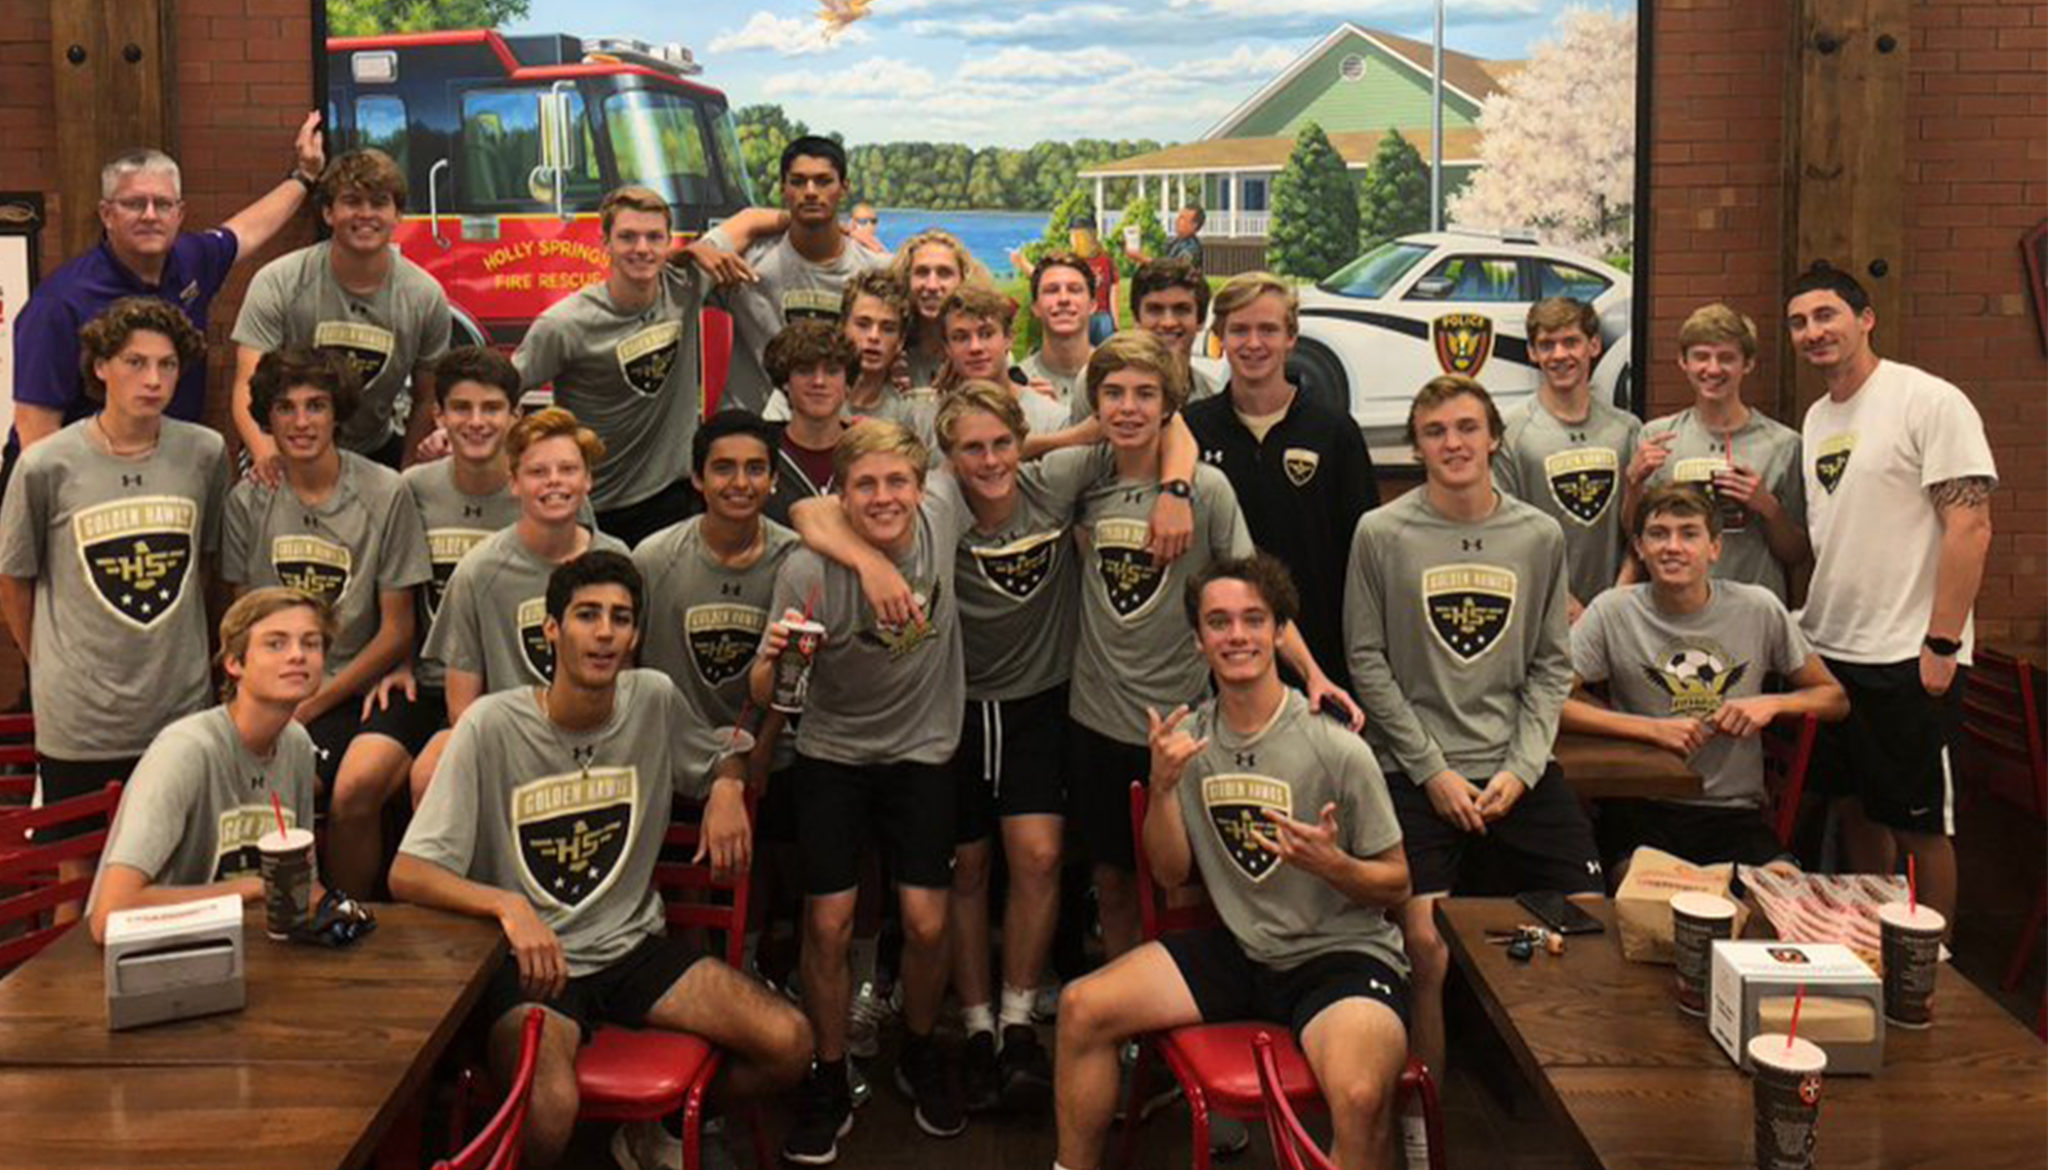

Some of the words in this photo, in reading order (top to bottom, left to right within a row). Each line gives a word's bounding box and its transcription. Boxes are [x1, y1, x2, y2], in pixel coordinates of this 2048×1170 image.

[482, 241, 534, 272] HOLLY
[495, 273, 532, 290] FIRE
[538, 271, 602, 290] RESCUE
[1443, 313, 1485, 328] POLICE
[82, 507, 140, 538] GOLDEN
[524, 780, 582, 815] GOLDEN
